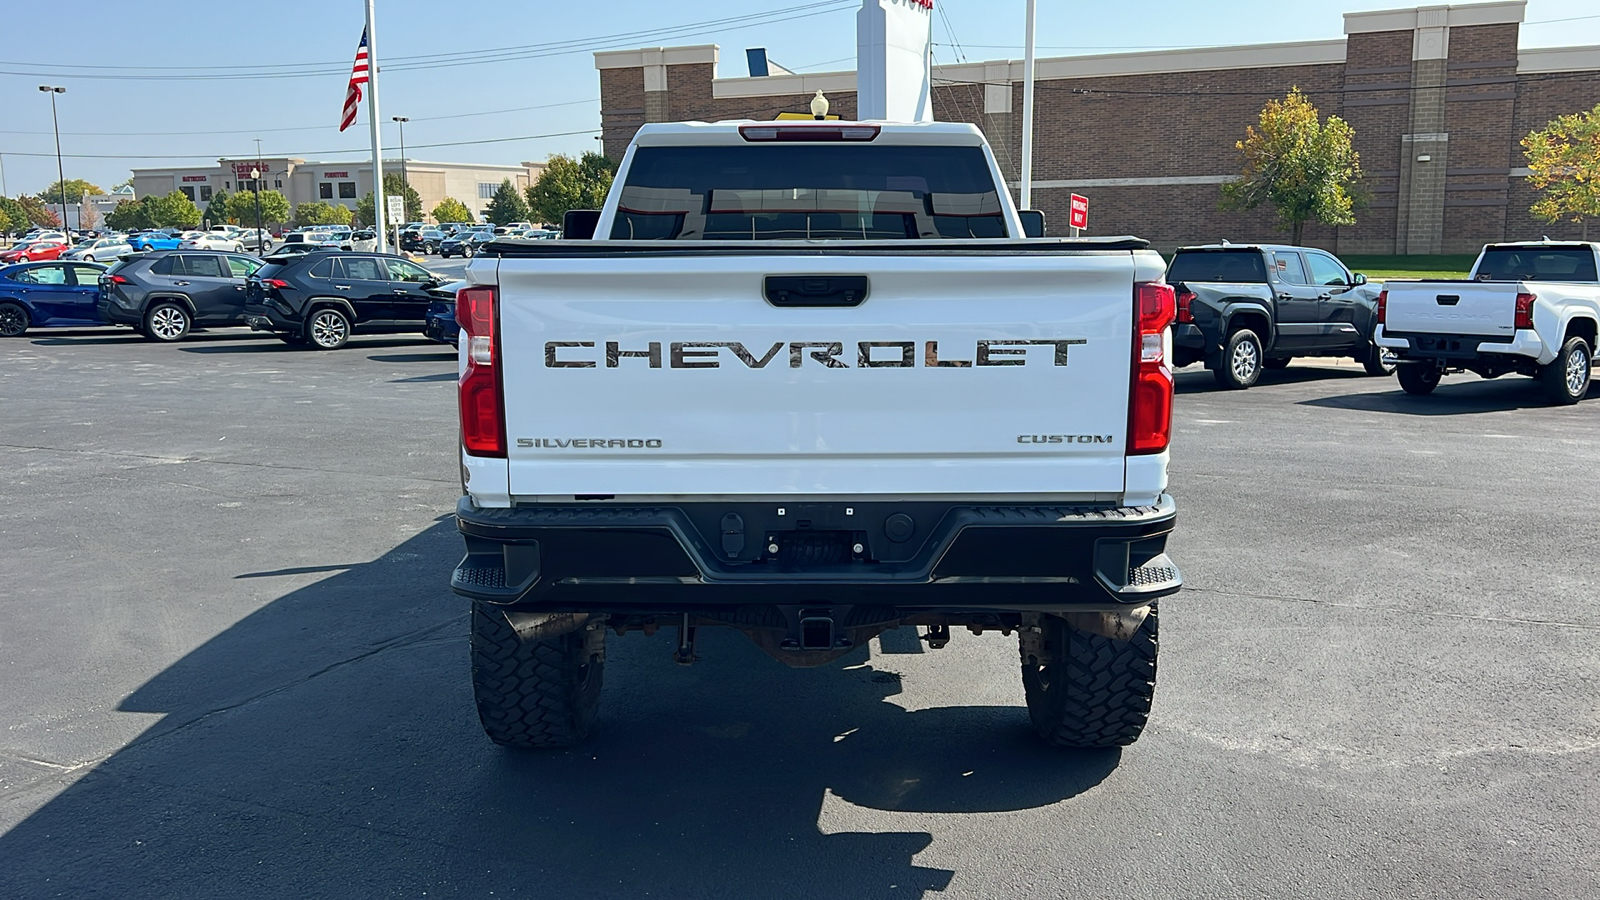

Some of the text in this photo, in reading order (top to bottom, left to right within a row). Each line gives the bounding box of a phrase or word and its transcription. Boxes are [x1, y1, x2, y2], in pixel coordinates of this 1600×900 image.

[544, 338, 1087, 369] CHEVROLET
[516, 438, 662, 448] SILVERADO
[1016, 434, 1113, 444] CUSTOM
